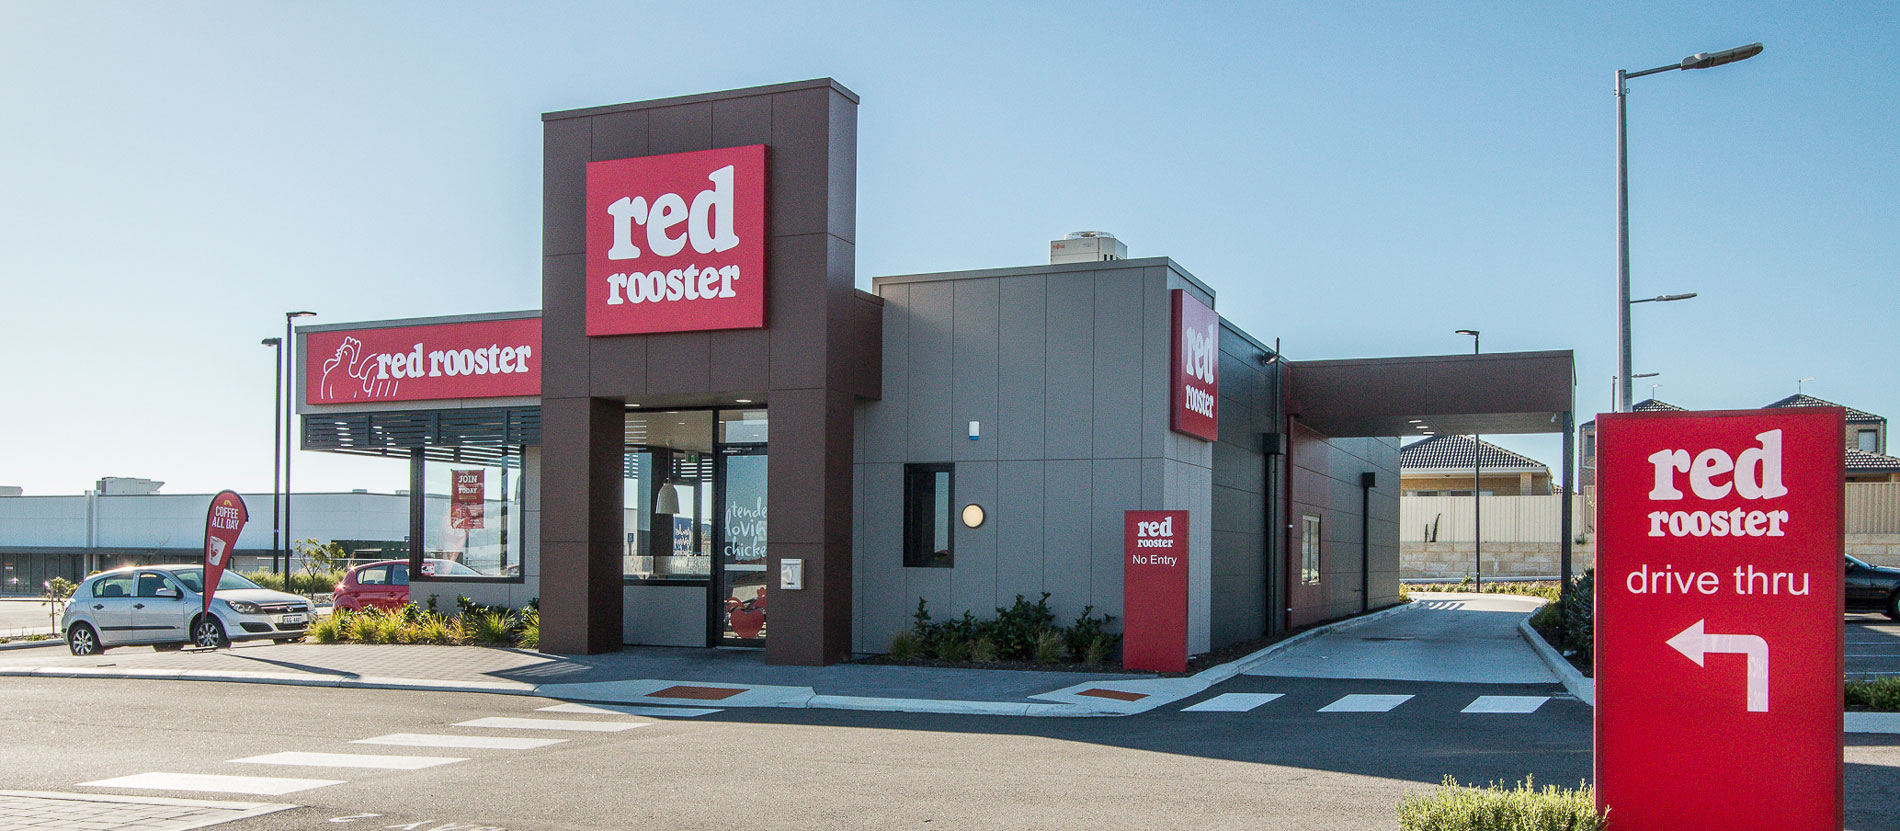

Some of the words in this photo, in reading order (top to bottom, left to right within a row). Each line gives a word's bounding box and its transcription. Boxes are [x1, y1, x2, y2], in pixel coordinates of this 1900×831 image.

[607, 164, 740, 260] red
[606, 263, 740, 305] rooster
[376, 342, 425, 380] red
[428, 343, 531, 377] rooster
[1186, 323, 1214, 385] red
[1185, 383, 1214, 419] rooster
[1647, 428, 1788, 500] red
[458, 475, 478, 483] JOIN
[215, 505, 239, 519] COFFEE
[731, 496, 767, 518] tende
[1647, 506, 1789, 537] rooster
[211, 516, 225, 529] ALL
[225, 518, 240, 530] DAY
[725, 508, 767, 537] lovin
[1137, 516, 1173, 537] red
[724, 536, 767, 558] chicke
[1137, 538, 1174, 548] rooster
[1132, 554, 1148, 565] No
[1150, 554, 1178, 568] Entry
[1626, 564, 1720, 595] drive
[1733, 564, 1809, 596] thru
